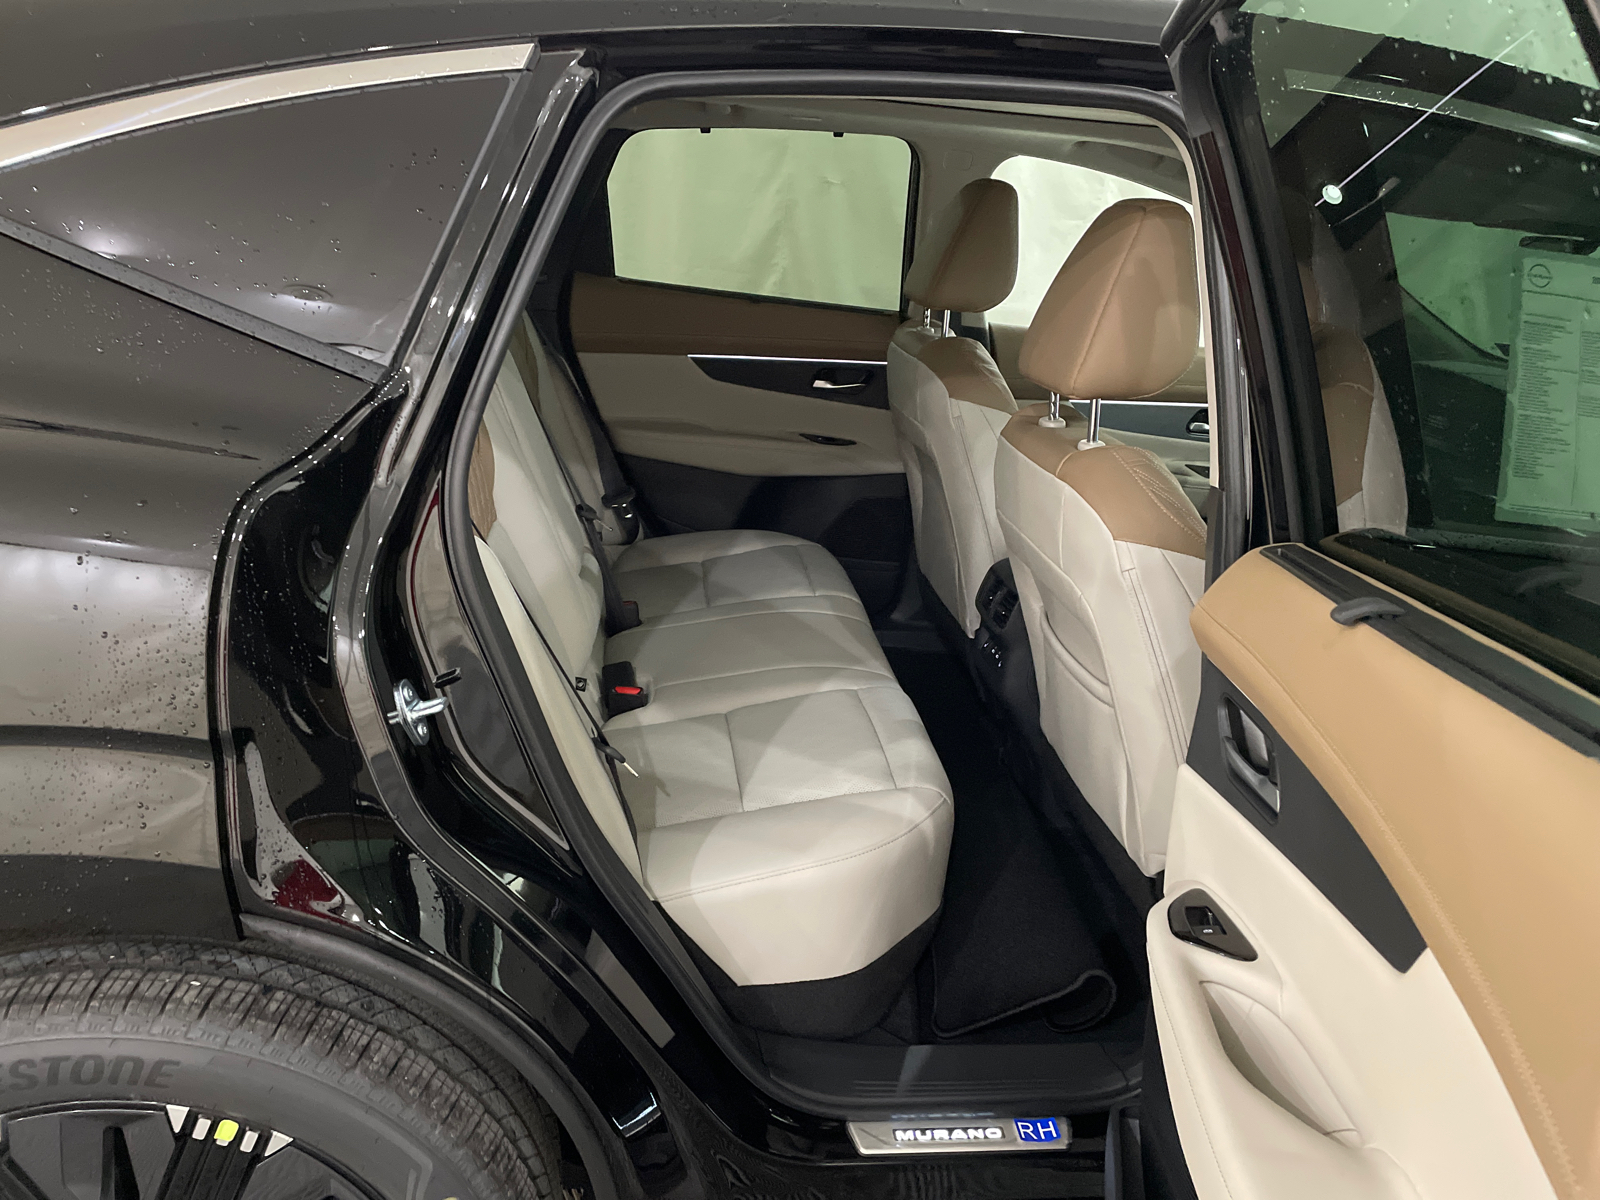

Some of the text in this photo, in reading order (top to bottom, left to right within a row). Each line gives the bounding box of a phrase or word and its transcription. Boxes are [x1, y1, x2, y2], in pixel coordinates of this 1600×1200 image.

[0, 1054, 181, 1095] STONE
[895, 1127, 1003, 1142] MURANO
[1017, 1120, 1057, 1140] RH
